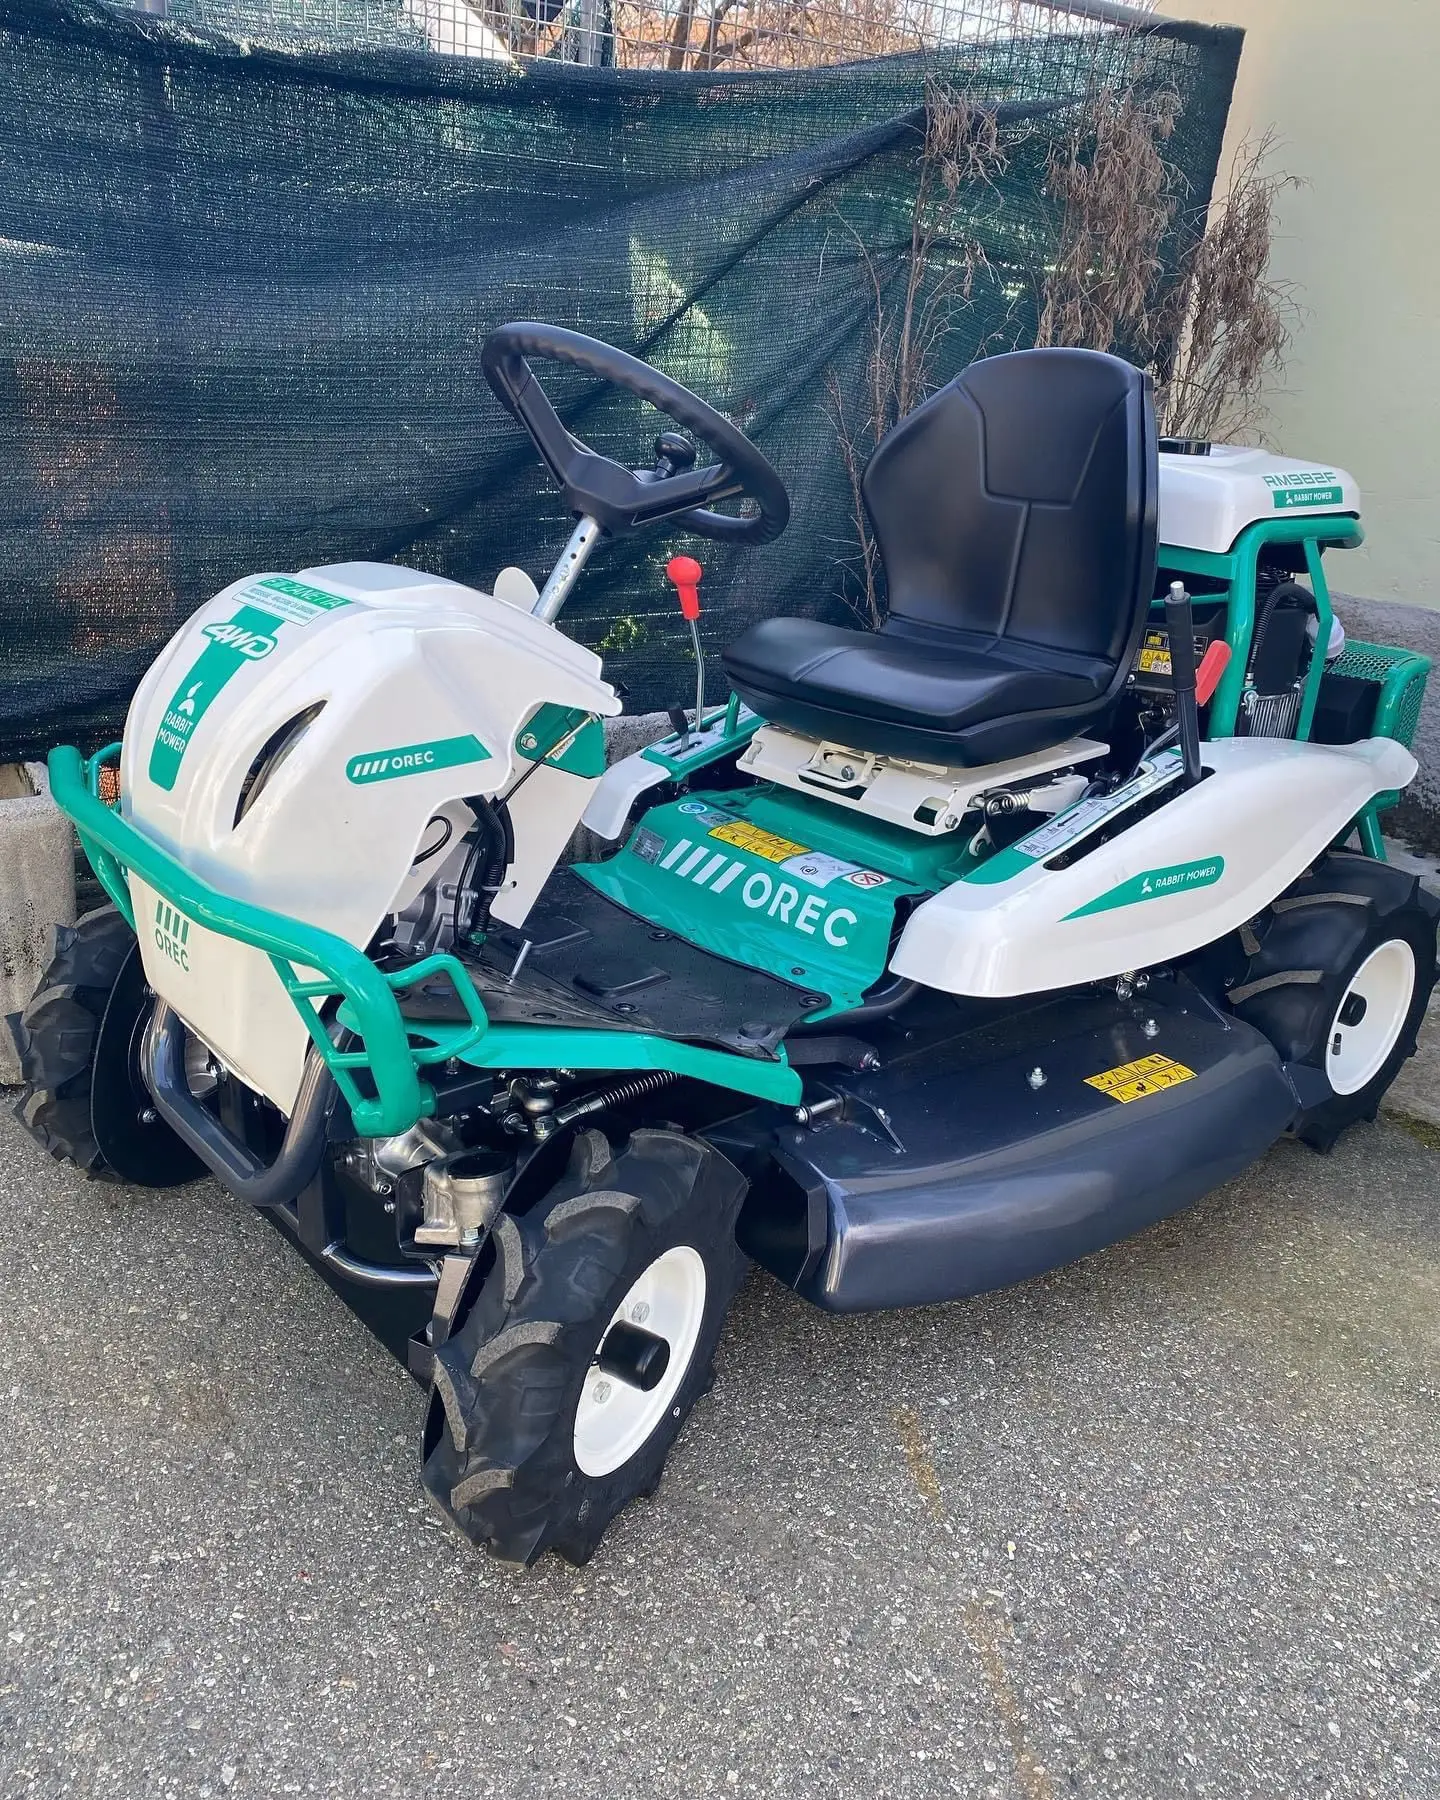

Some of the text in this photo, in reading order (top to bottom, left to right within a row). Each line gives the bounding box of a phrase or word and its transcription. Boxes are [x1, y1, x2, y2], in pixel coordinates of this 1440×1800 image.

[1262, 471, 1336, 487] RM982F
[1294, 492, 1332, 502] RABBIT MOWER
[204, 625, 275, 658] 4WD
[164, 711, 193, 735] RABBIT
[157, 728, 185, 753] MOWER
[391, 751, 434, 769] OREC
[1155, 866, 1216, 888] RABBIT MOWER
[742, 872, 858, 947] OREC
[155, 928, 189, 972] OREC
